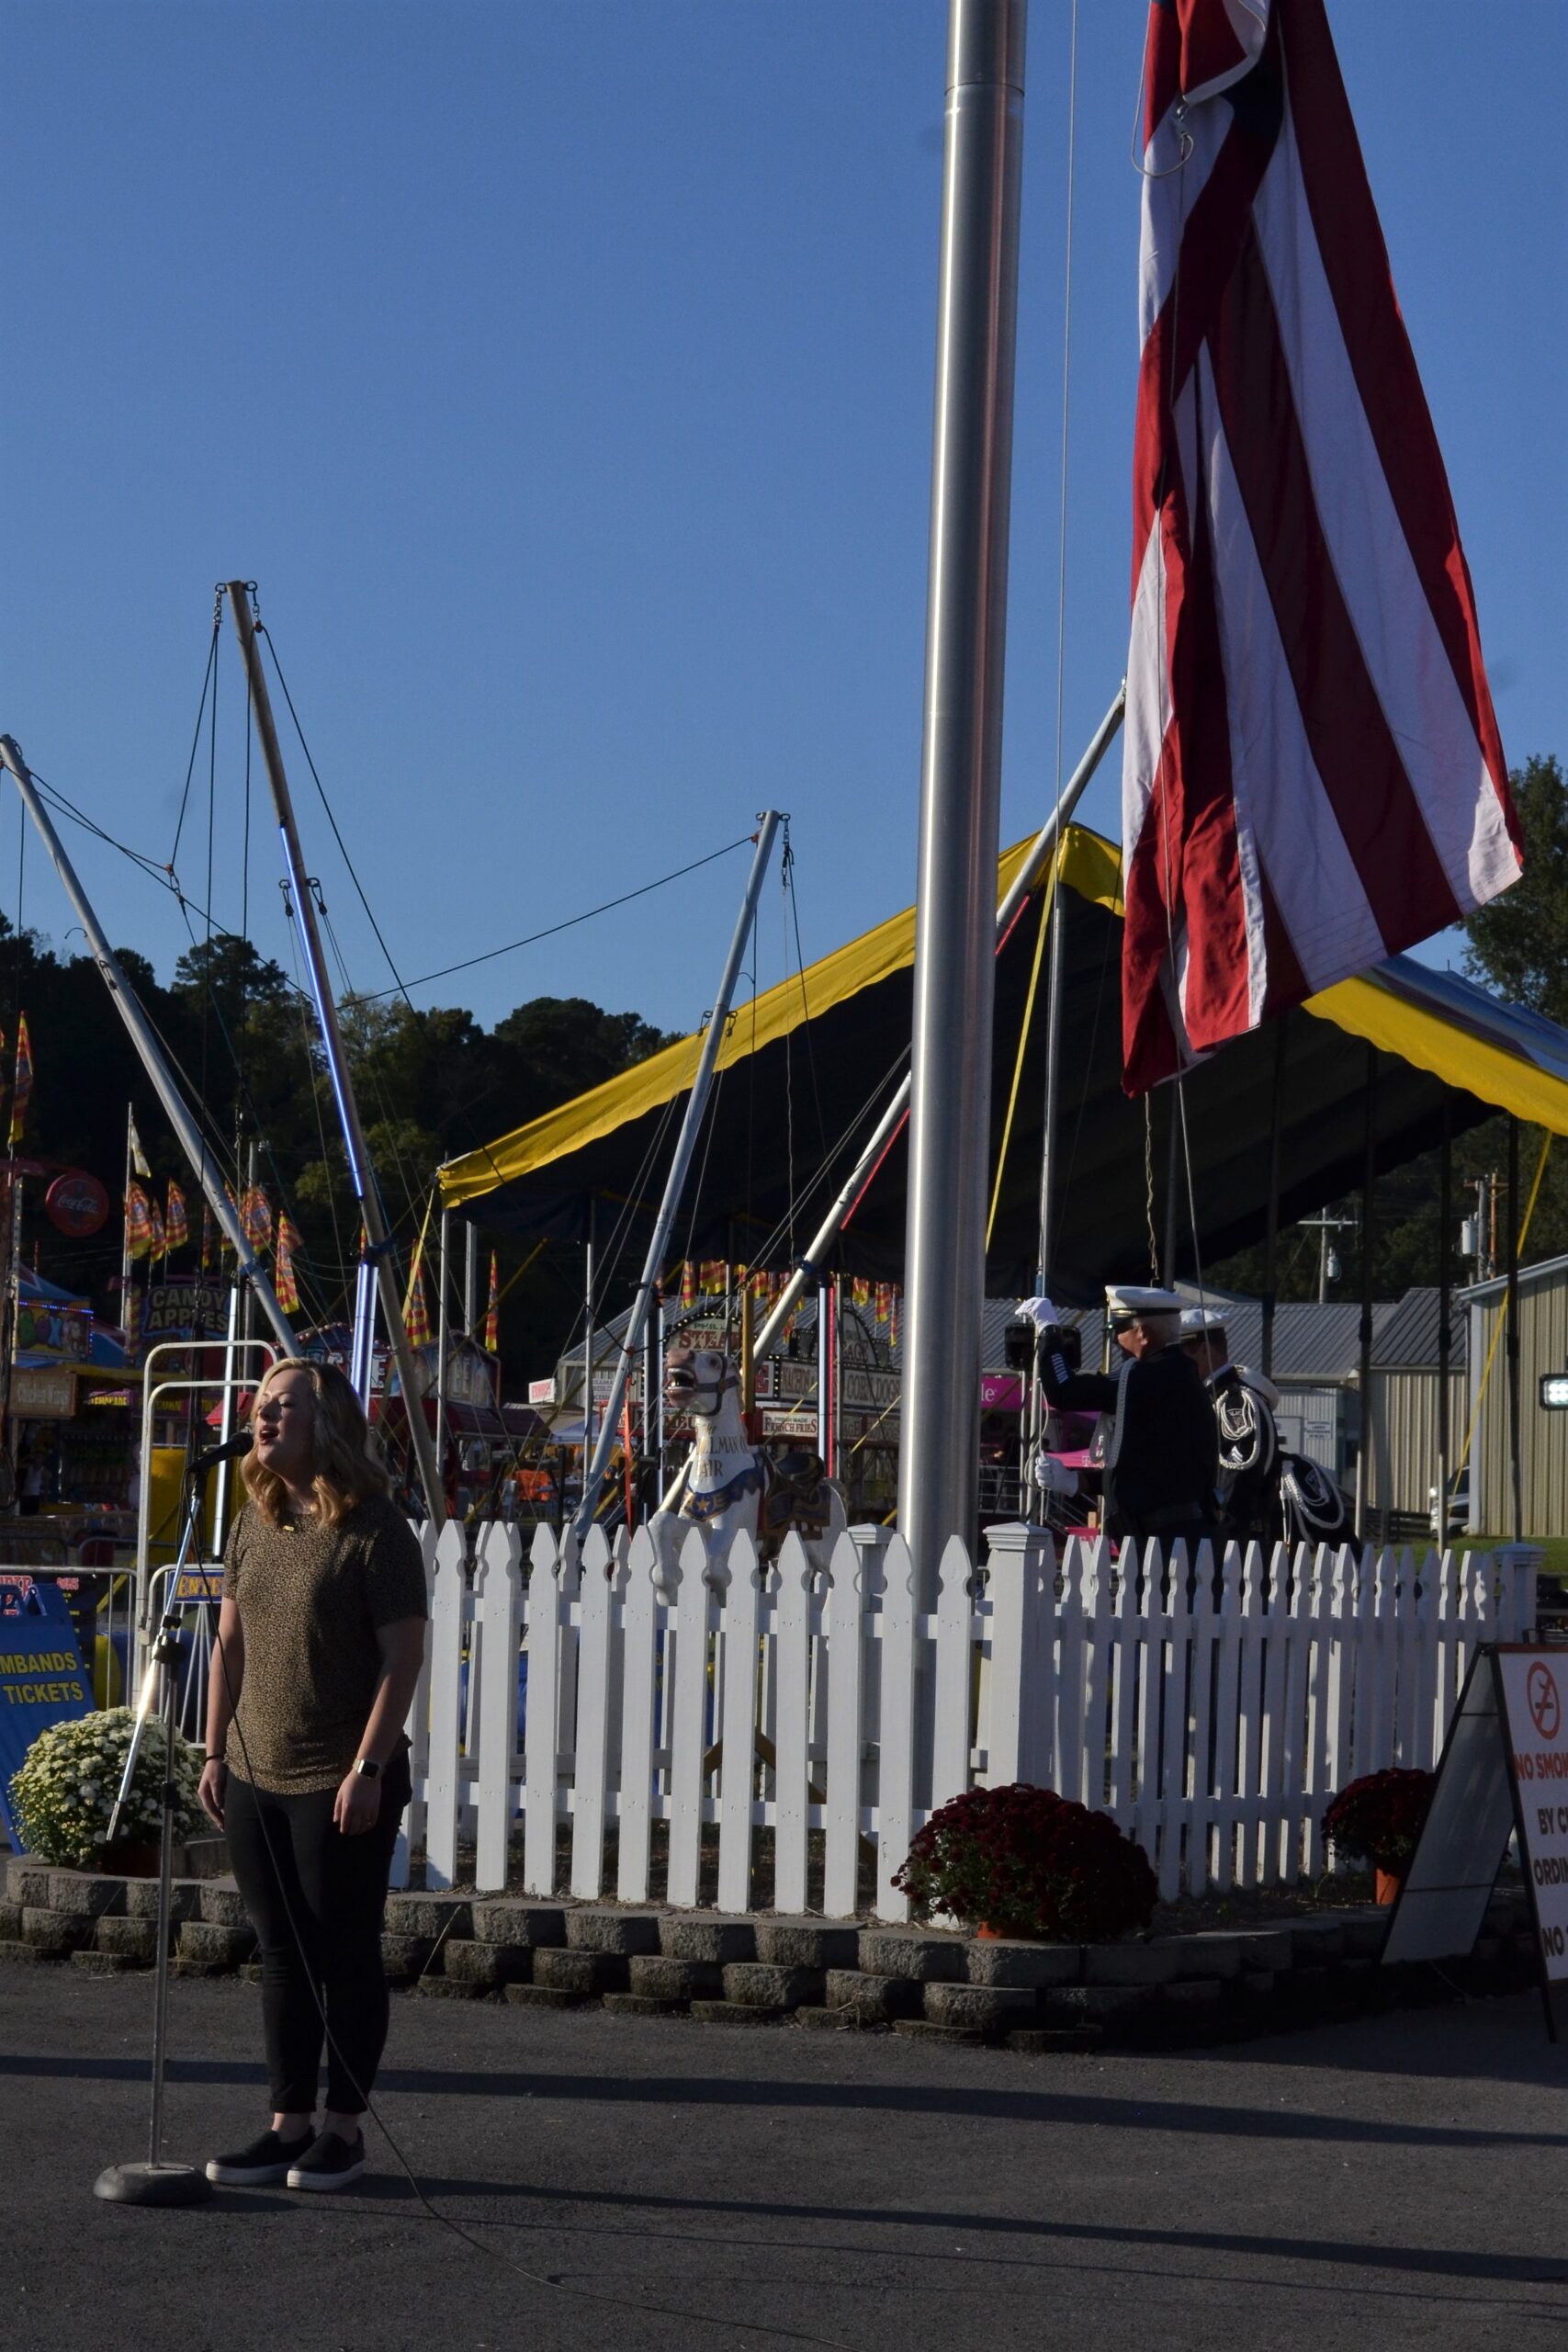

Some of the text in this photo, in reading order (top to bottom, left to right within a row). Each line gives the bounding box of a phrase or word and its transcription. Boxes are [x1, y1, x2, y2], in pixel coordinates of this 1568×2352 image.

[152, 1288, 227, 1311] CANDY
[763, 1418, 818, 1435] FRENCH FRIES
[177, 1576, 223, 1598] ENTE
[0, 1652, 78, 1675] MBANDS
[2, 1681, 85, 1705] TICKETS
[1513, 1753, 1534, 1781] NO
[1538, 1806, 1568, 1835] BY C
[1542, 1926, 1564, 1957] NO
